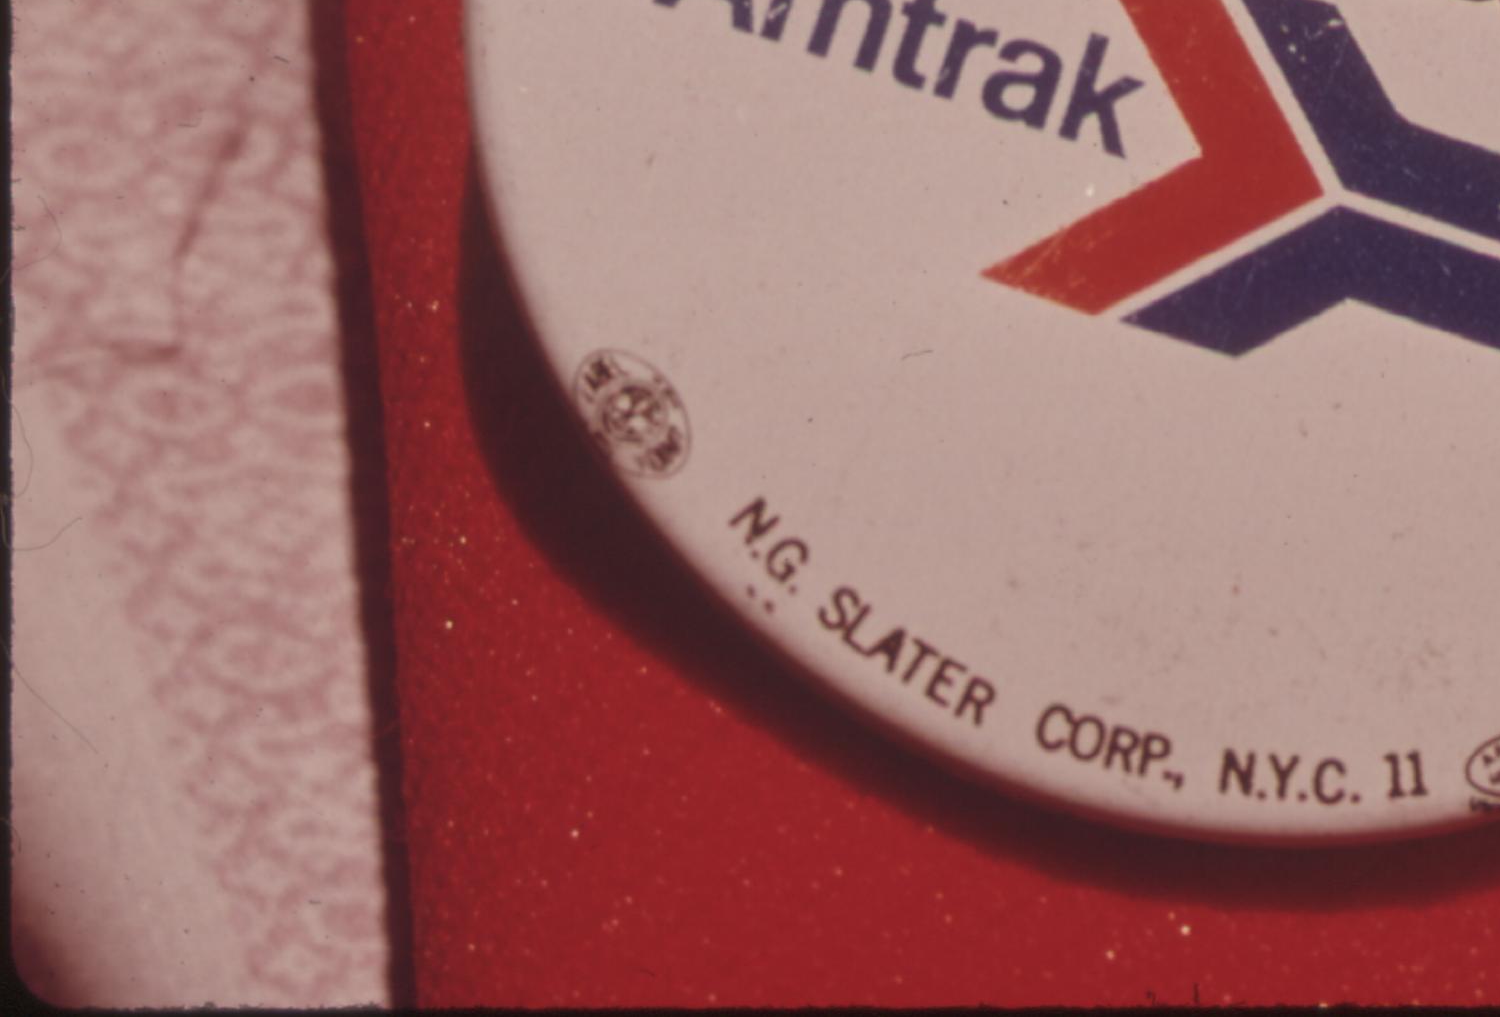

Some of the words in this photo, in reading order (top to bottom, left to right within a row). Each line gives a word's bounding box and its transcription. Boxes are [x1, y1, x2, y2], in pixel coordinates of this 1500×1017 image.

[728, 496, 809, 595] N.G.
[817, 586, 996, 727] SLATER
[1218, 748, 1361, 807] N.Y.C.
[1383, 749, 1429, 802] 11
